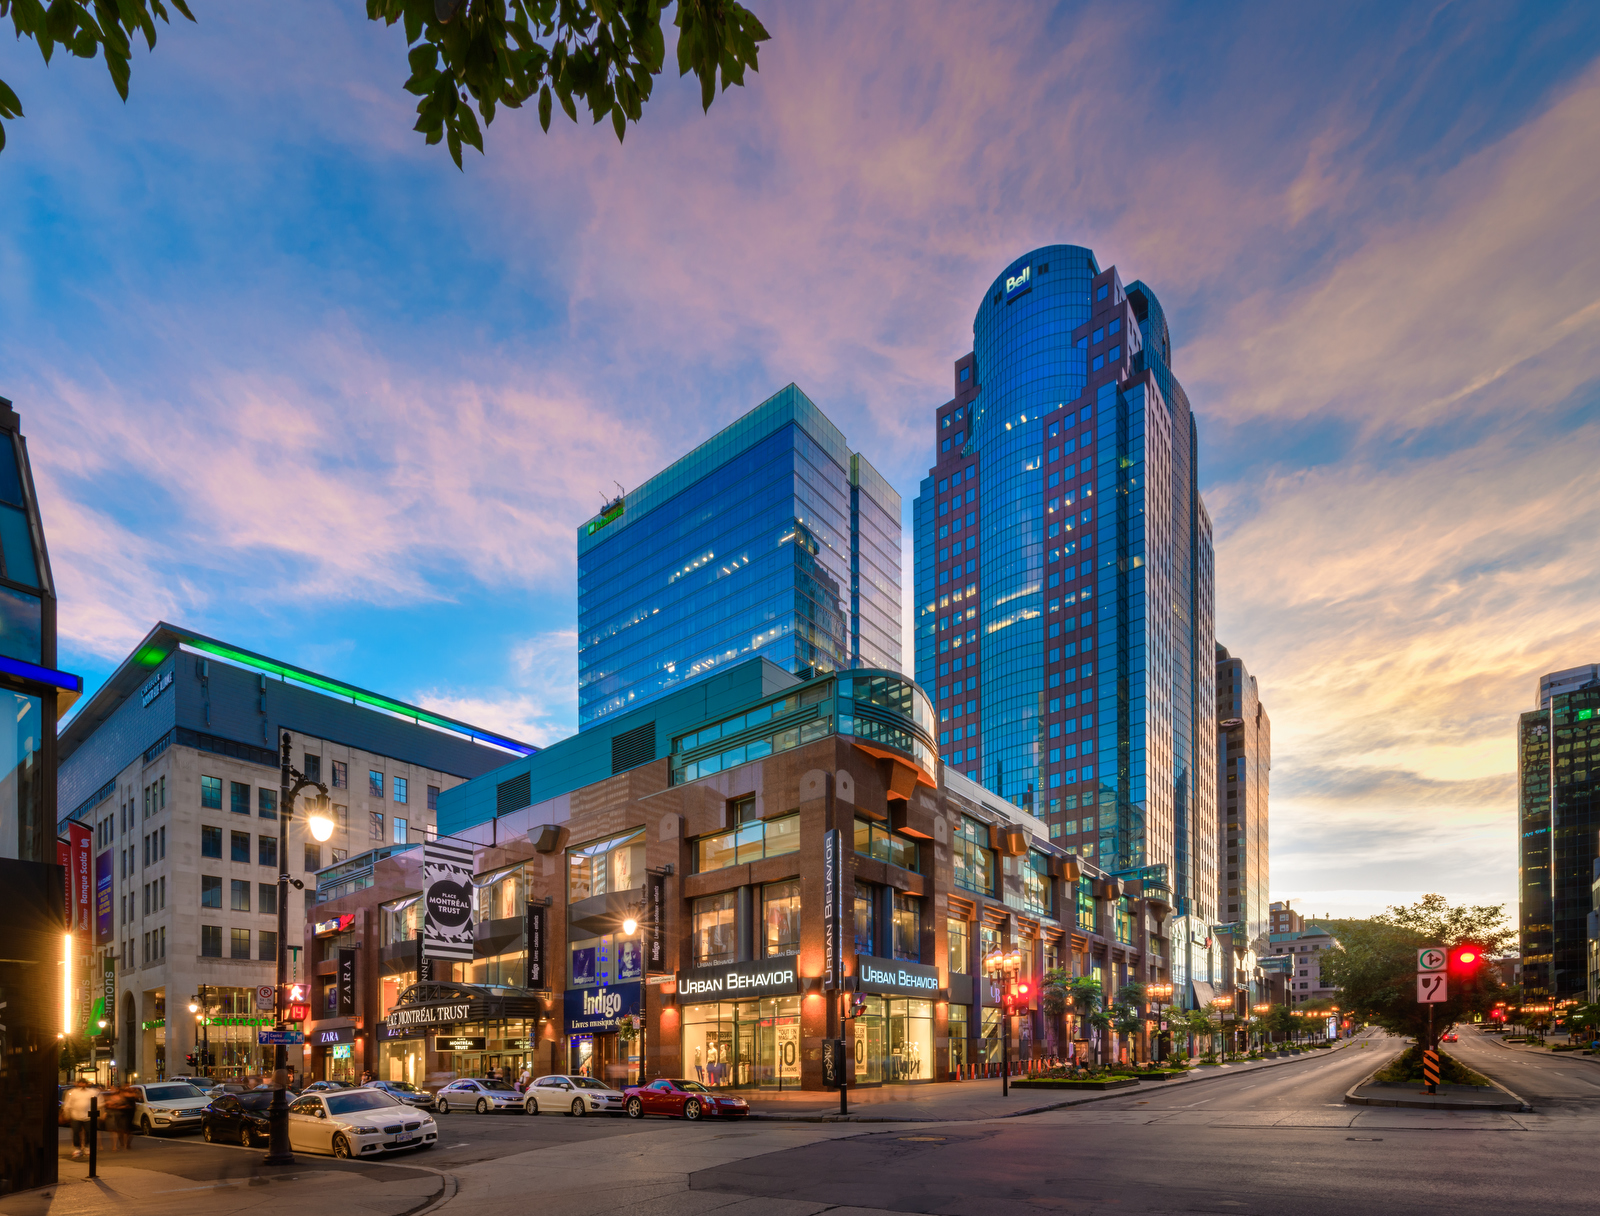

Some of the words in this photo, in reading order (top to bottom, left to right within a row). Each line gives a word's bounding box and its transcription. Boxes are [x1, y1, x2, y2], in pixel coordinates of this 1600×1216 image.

[1006, 265, 1030, 293] Bell
[79, 851, 88, 874] Scotia
[824, 836, 833, 919] BEHAVIOR
[81, 876, 89, 904] Banque
[429, 896, 469, 908] MONTRÉAL
[438, 905, 460, 915] TRUST
[652, 941, 660, 961] Indigo
[825, 924, 833, 985] URBAN
[343, 960, 351, 1004] ZARA
[532, 963, 540, 980] Indigo
[679, 978, 722, 995] URBAN
[726, 970, 793, 990] BEHAVIOR
[861, 964, 896, 985] URBAN
[898, 969, 938, 990] BEHAVIOR
[292, 1006, 304, 1019] 14
[583, 988, 621, 1018] Indigo
[212, 1017, 275, 1027] simons
[398, 1007, 436, 1025] MONTRÉAL
[437, 1004, 470, 1021] TRUST
[571, 1020, 589, 1029] Livres
[589, 1018, 614, 1029] musique
[321, 1031, 339, 1043] ZARA
